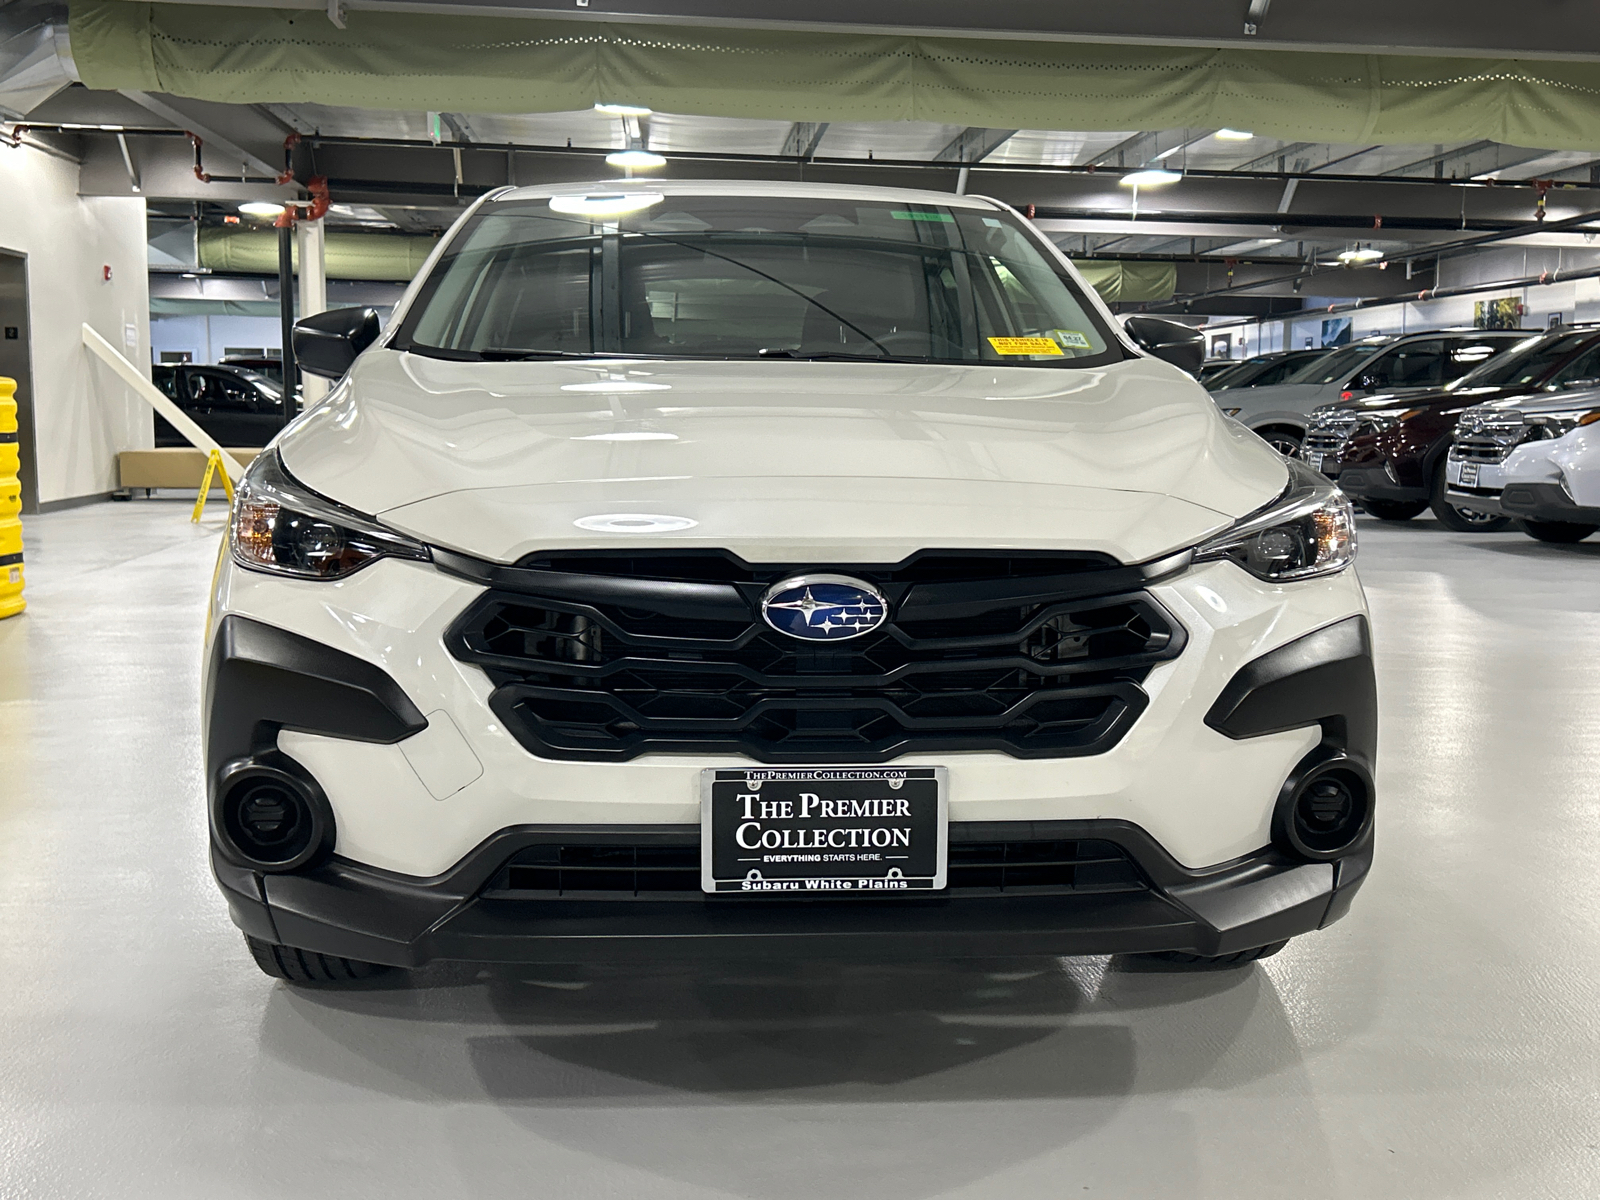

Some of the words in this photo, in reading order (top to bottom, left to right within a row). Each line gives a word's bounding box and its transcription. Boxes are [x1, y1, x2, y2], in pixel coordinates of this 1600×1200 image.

[736, 793, 794, 819] THE
[799, 792, 912, 818] PREMIER
[735, 822, 912, 850] COLLECTION
[822, 854, 856, 862] STARTS
[857, 853, 883, 861] HERE.
[741, 880, 799, 890] Subaru
[804, 880, 852, 890] White
[858, 879, 908, 889] Plains
